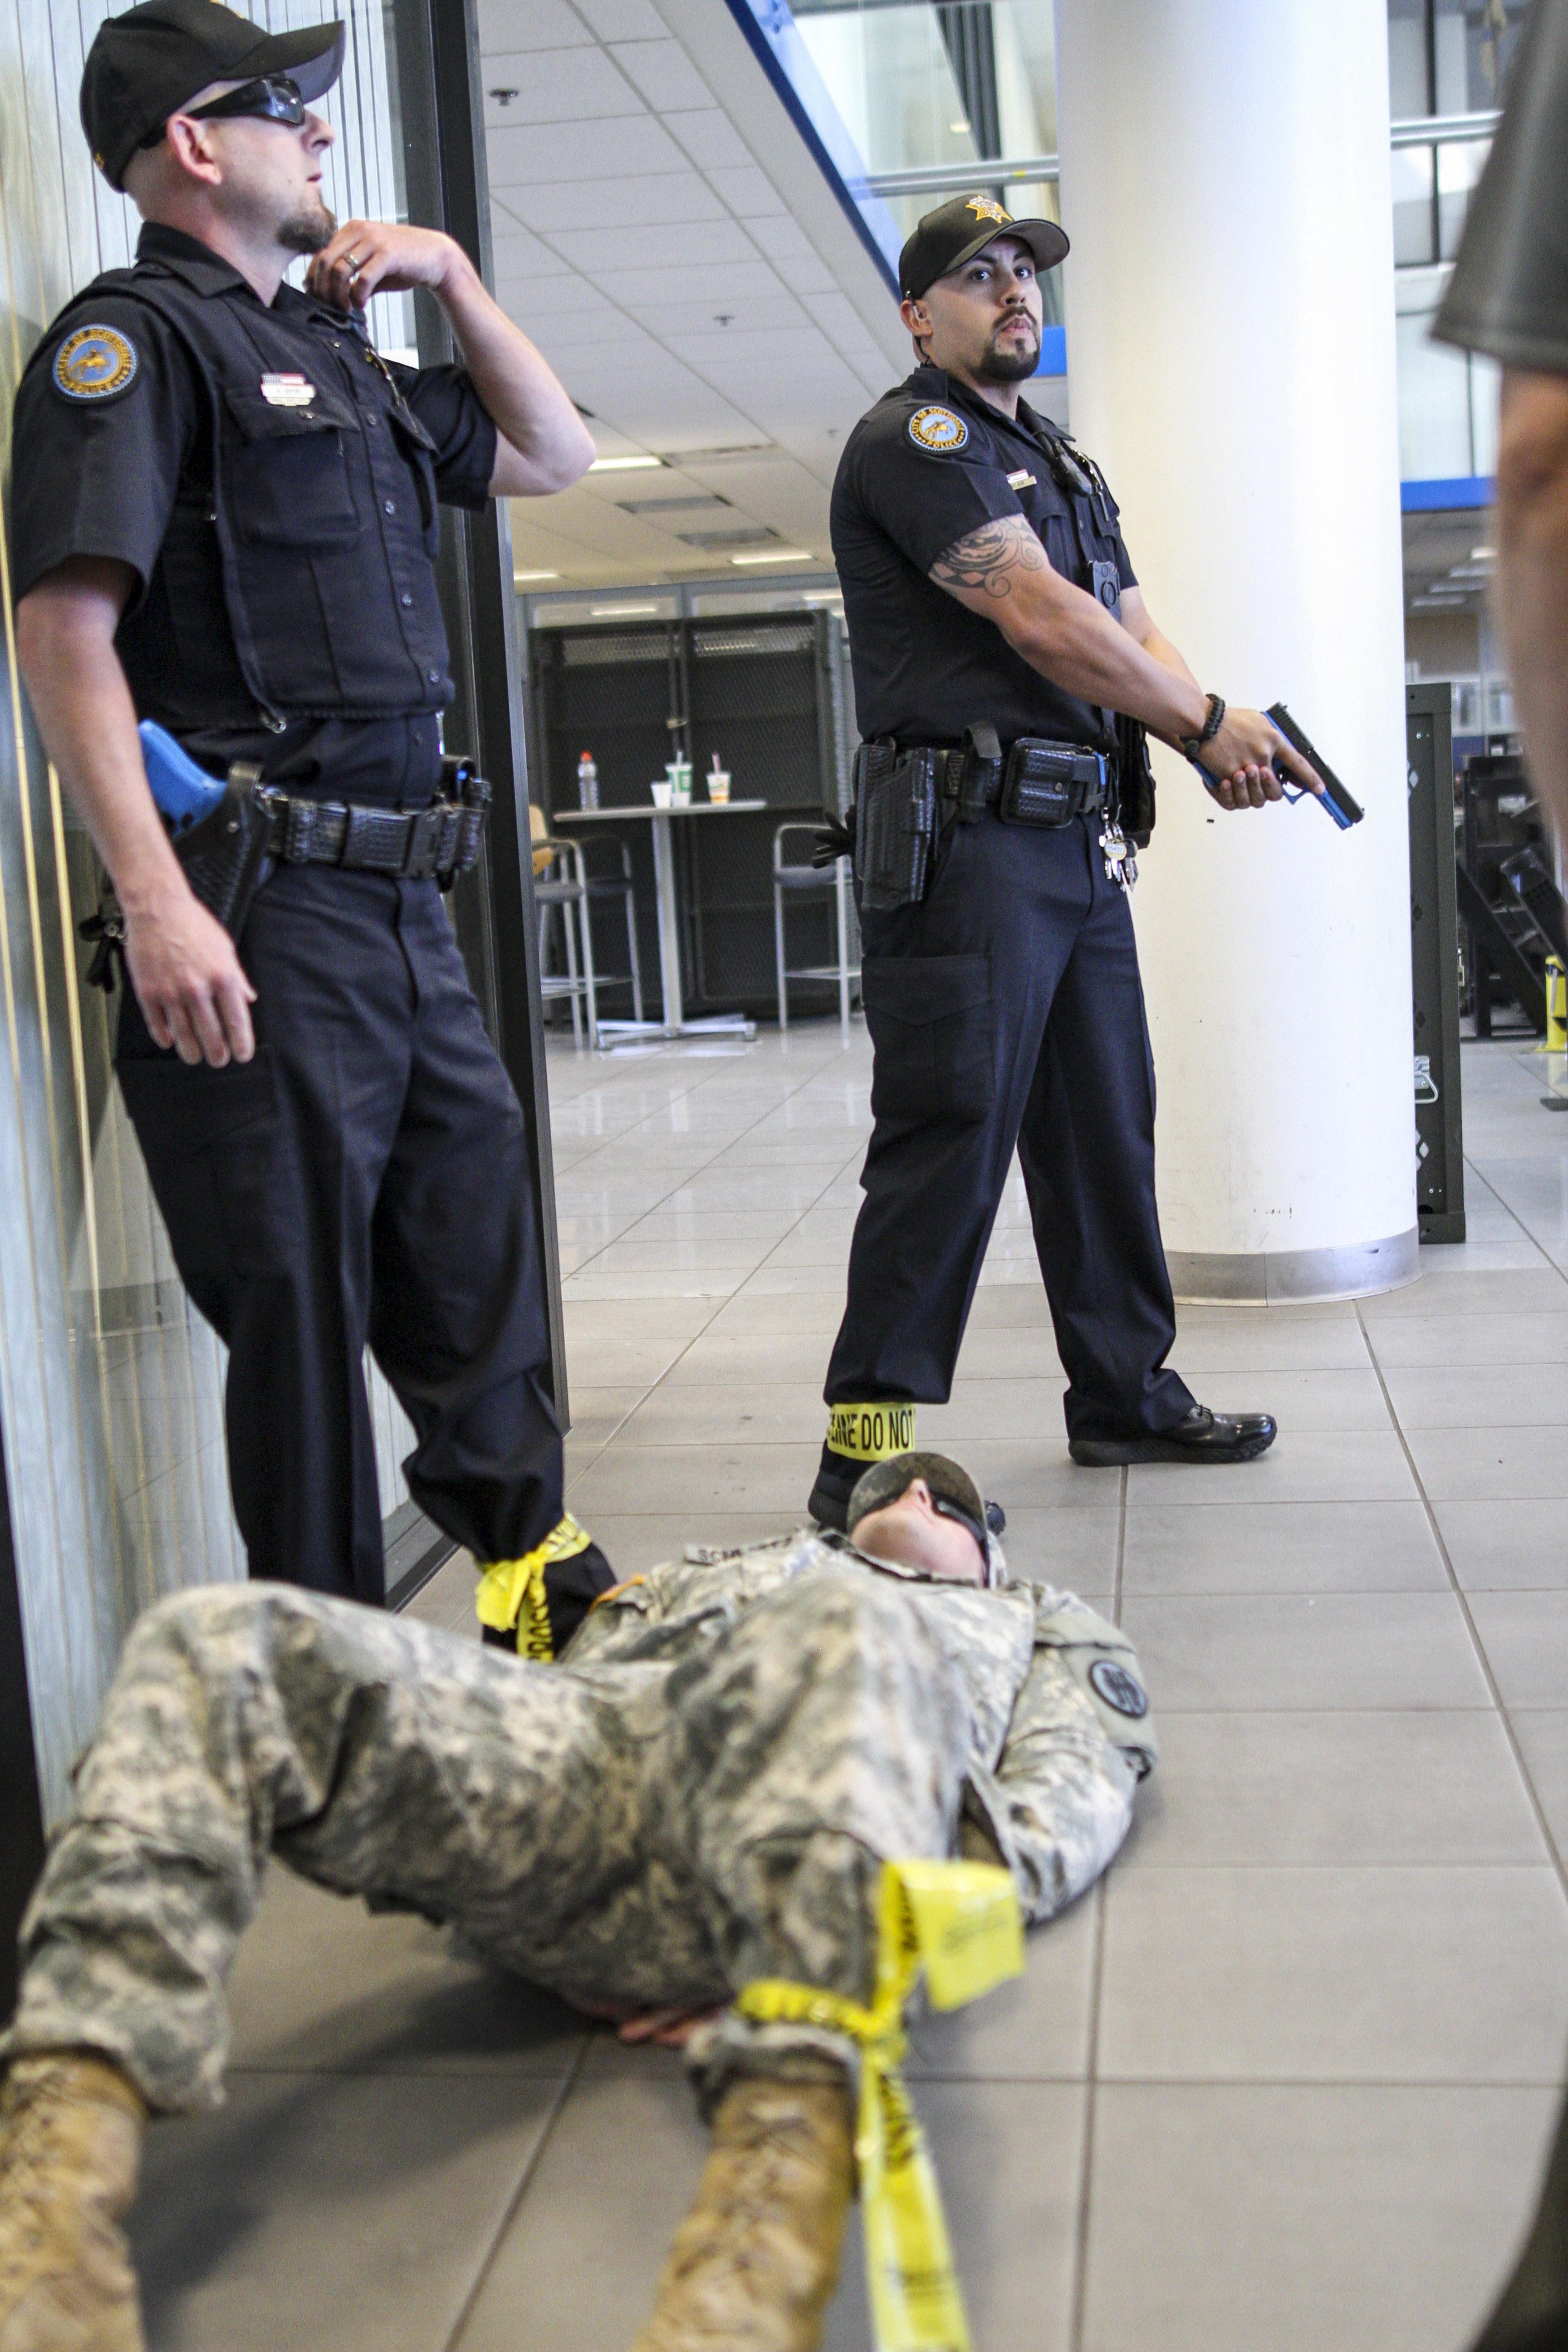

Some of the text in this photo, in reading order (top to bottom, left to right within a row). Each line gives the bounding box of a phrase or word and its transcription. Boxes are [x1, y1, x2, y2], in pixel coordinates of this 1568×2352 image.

[917, 411, 927, 419] OF
[926, 439, 960, 448] POLICE
[862, 1412, 883, 1450] DO
